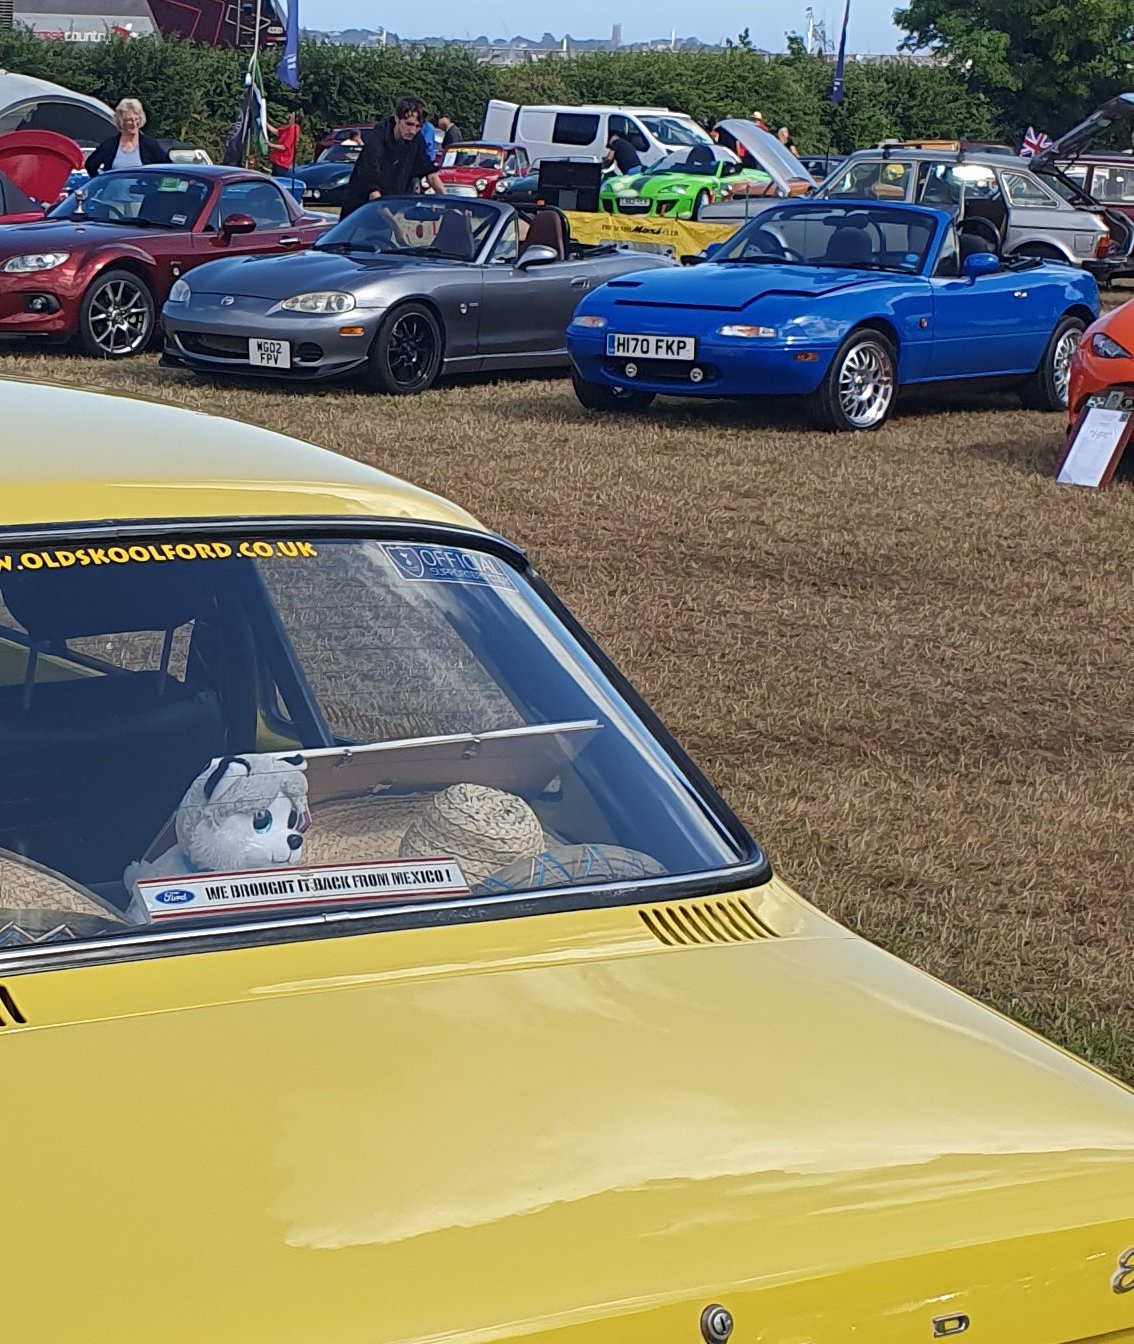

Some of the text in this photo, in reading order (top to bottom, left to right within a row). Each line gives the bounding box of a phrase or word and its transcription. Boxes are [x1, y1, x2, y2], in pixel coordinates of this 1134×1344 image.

[257, 341, 283, 354] WG02
[616, 337, 687, 356] H170 FKP
[260, 353, 279, 365] FPV
[419, 549, 504, 576] OFFICIAL
[205, 886, 229, 901] WE
[230, 879, 295, 899] BROUGHT
[297, 878, 310, 893] IT
[312, 875, 351, 891] BACK
[352, 872, 390, 888] FROM
[391, 868, 444, 885] MEXICO
[163, 891, 187, 902] Ford
